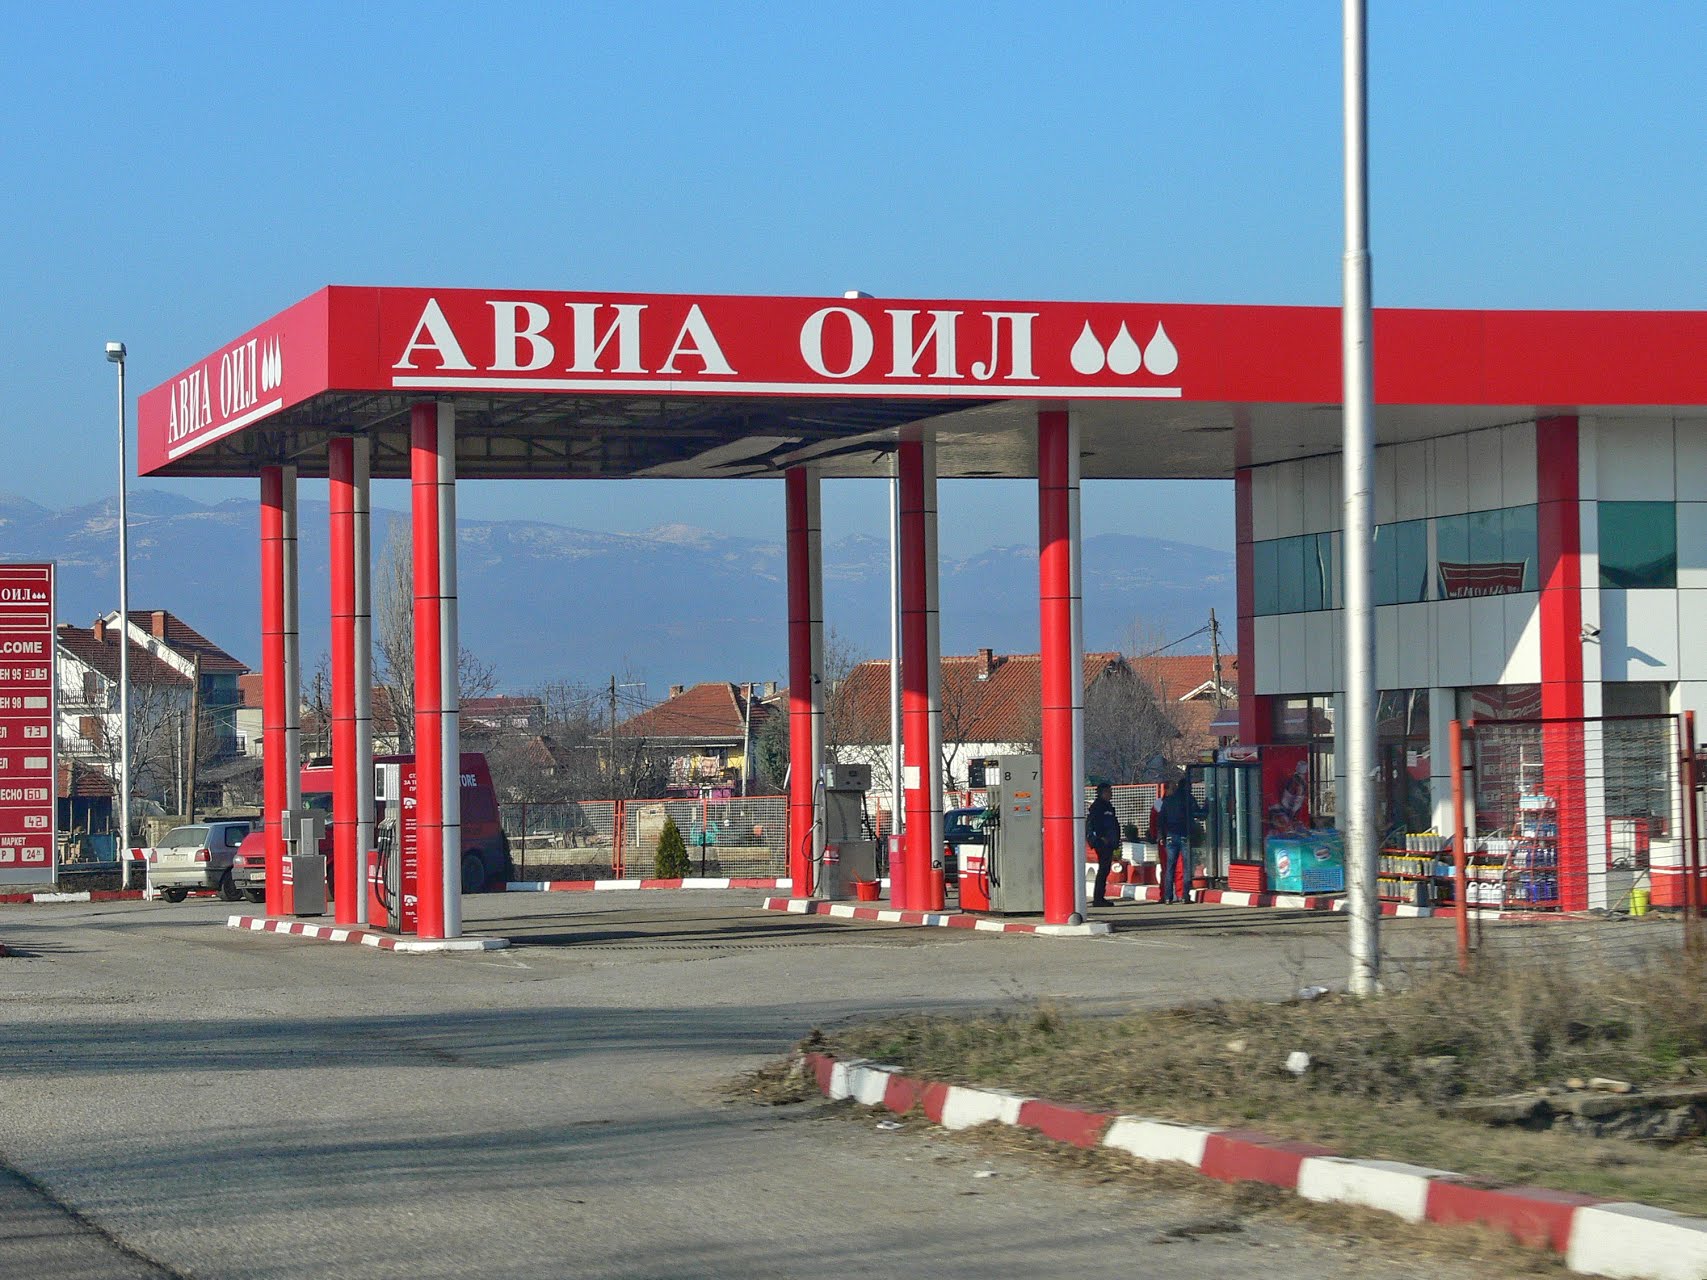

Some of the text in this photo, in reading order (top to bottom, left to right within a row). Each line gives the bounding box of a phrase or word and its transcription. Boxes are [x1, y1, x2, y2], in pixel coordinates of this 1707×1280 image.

[391, 297, 1040, 381] АВИА ОИЛ
[168, 338, 258, 444] АВИА ОИЛ
[1, 588, 31, 600] ОИЛ
[12, 668, 22, 680] 95
[12, 697, 22, 709] 98
[1004, 771, 1012, 781] 8
[1031, 771, 1039, 781] 7
[1, 837, 26, 846] МАРКЕТ
